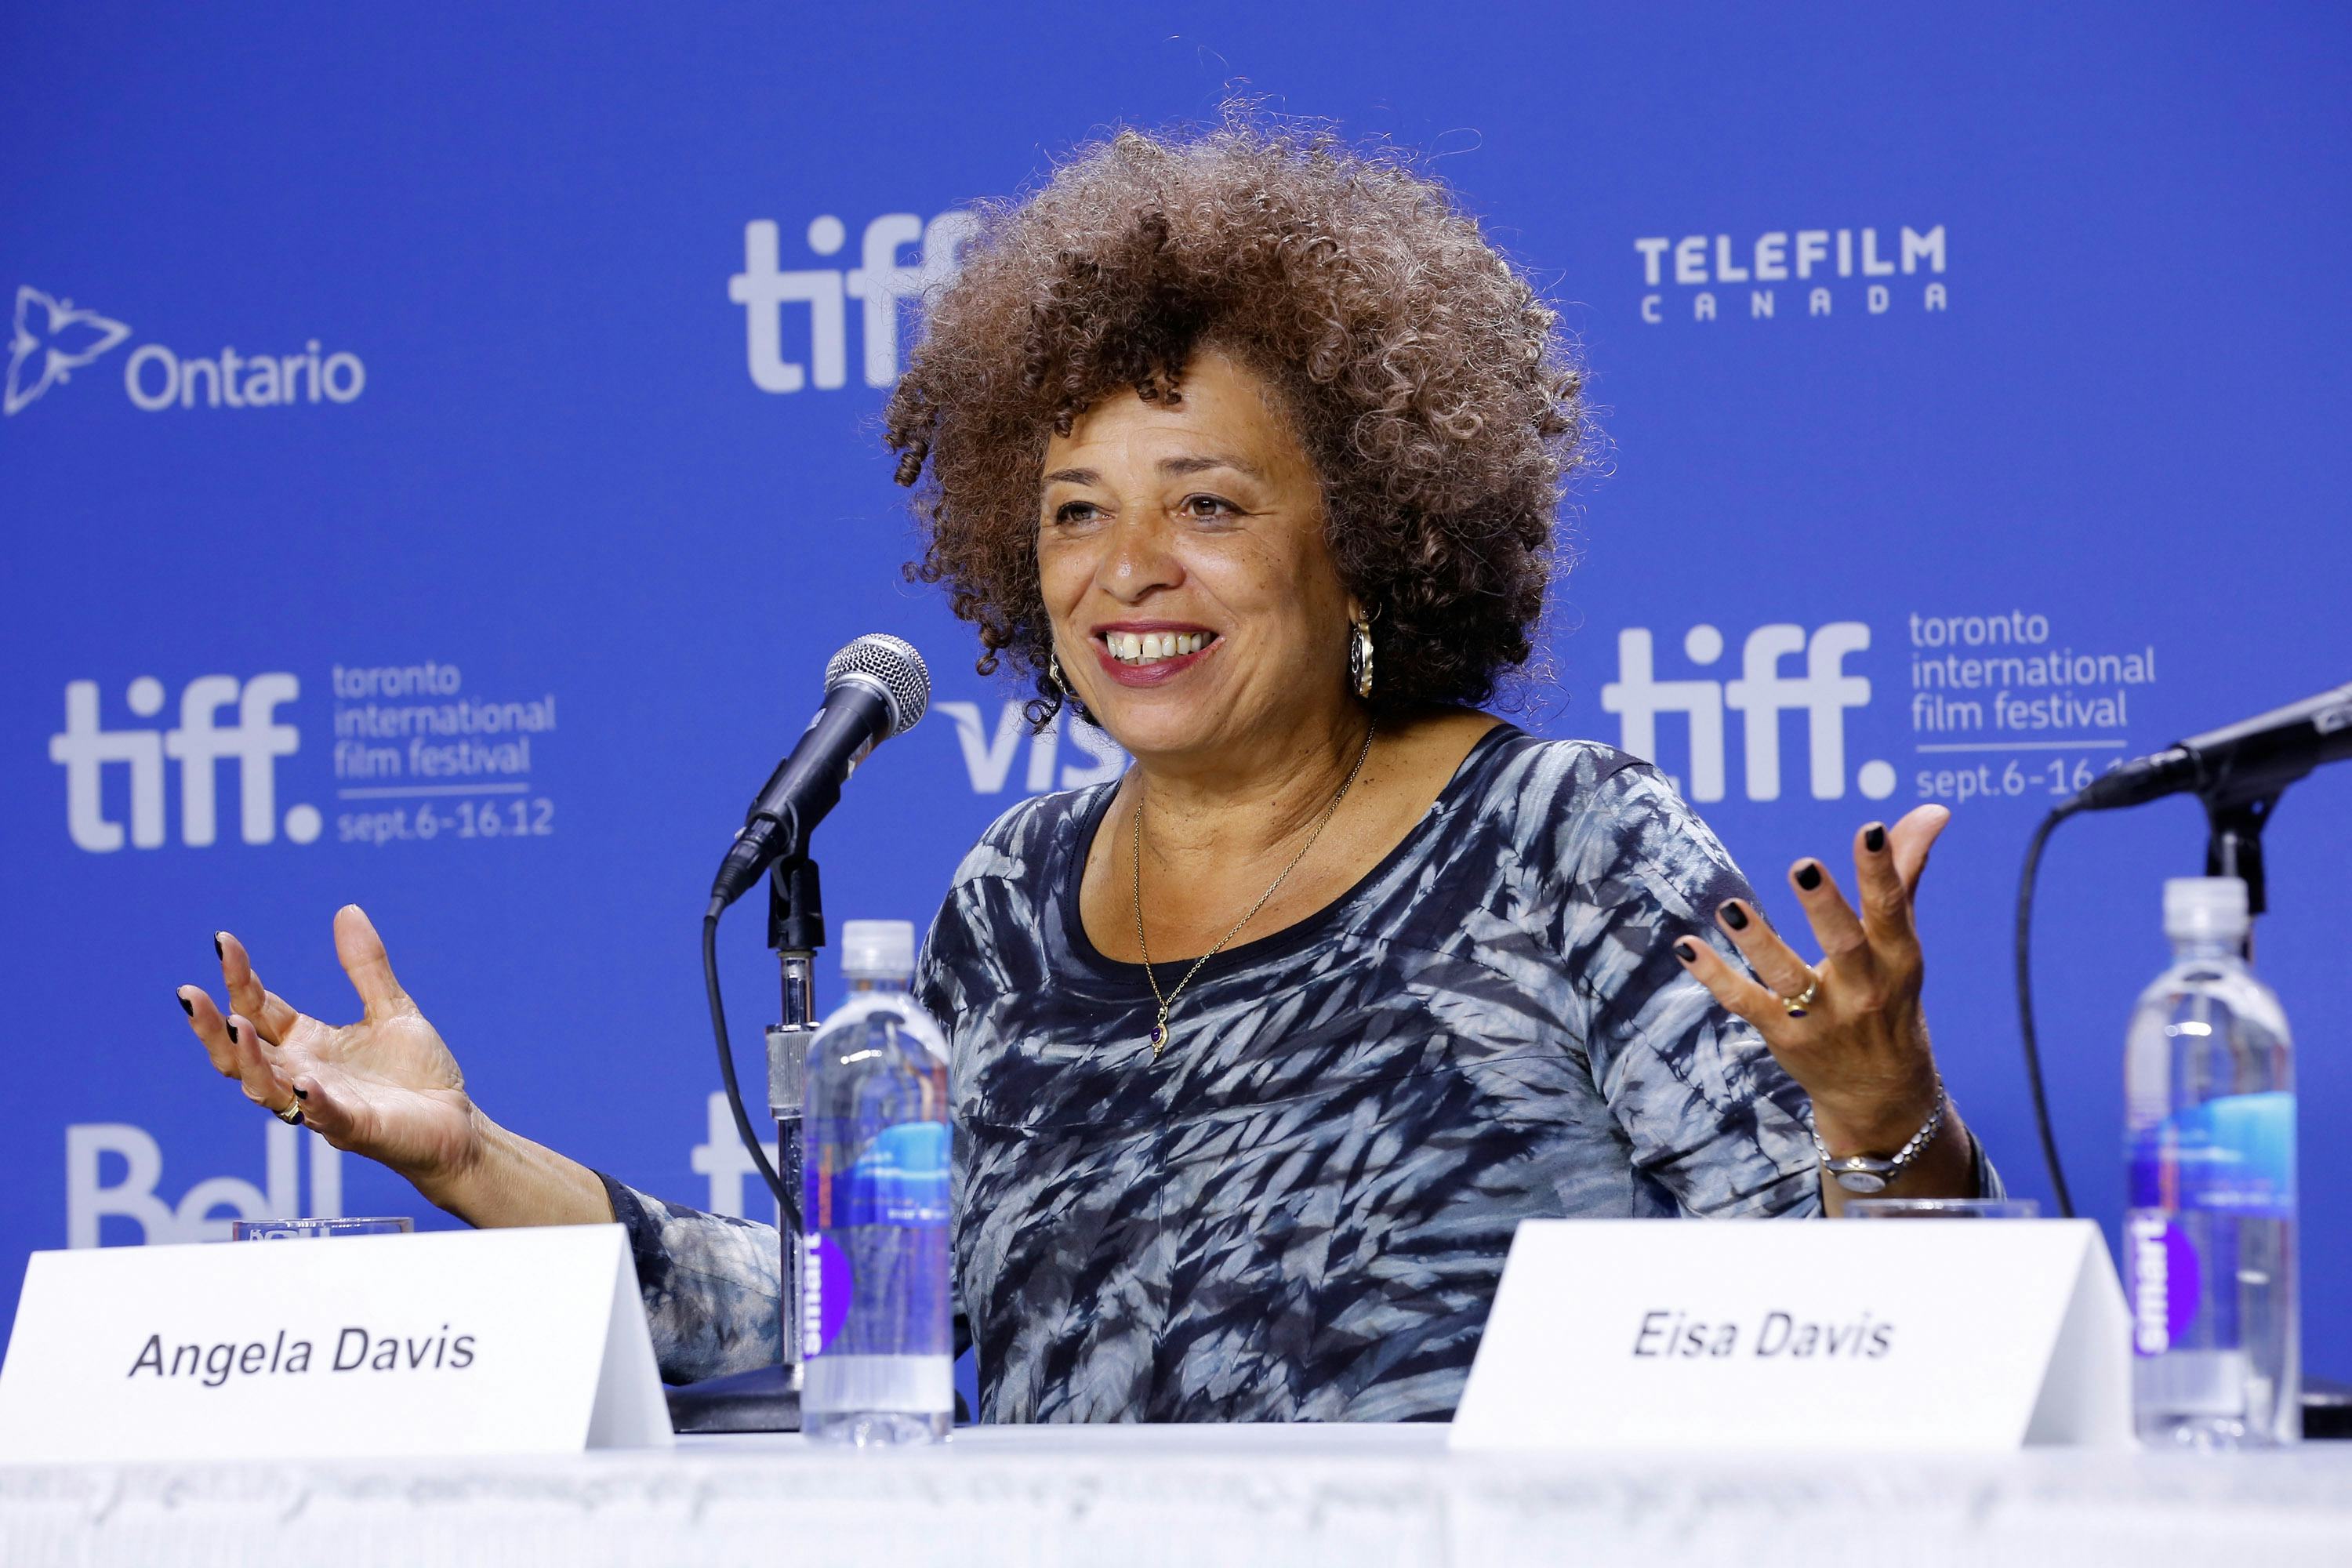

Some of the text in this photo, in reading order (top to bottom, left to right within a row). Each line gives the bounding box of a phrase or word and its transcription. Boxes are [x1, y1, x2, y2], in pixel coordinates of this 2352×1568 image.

[1635, 225, 1946, 285] TELEFILM
[1642, 283, 1947, 323] CANADA
[125, 339, 365, 411] Ontario
[1910, 610, 2049, 647] toronto
[333, 661, 461, 699] toronto
[1911, 647, 2155, 688] international
[335, 694, 555, 738] international
[1911, 690, 2127, 731] film festival
[335, 736, 530, 779] film festival
[935, 700, 1127, 793] VIS
[1916, 757, 2122, 804] sept.6-16
[67, 1120, 342, 1250] Bell
[128, 1323, 476, 1388] Angela Davis
[1633, 1311, 1894, 1358] Eisa Davis
